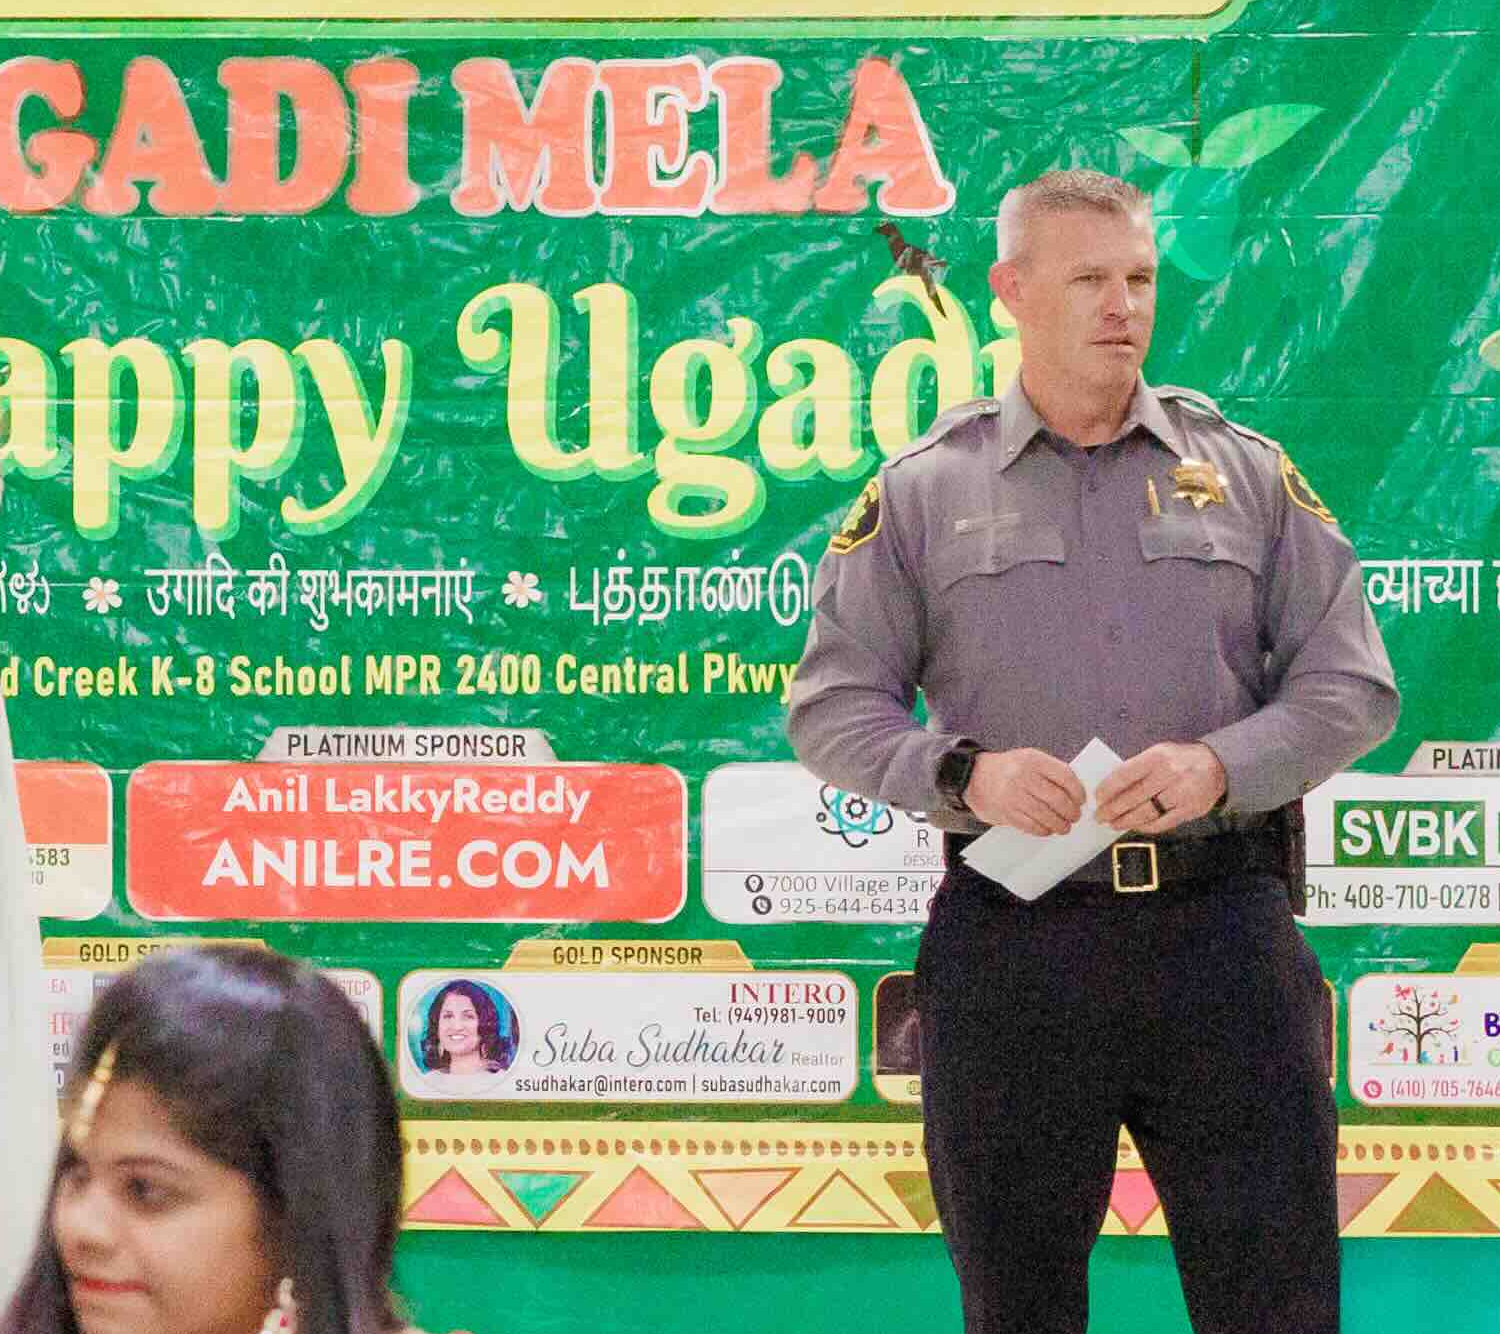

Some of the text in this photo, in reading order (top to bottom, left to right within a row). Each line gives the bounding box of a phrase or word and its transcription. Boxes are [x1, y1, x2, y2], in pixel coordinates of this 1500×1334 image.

[450, 55, 956, 218] MELA
[144, 553, 237, 619] उगादि
[246, 553, 290, 617] की
[33, 656, 138, 697] Creek
[151, 655, 216, 696] K-8
[230, 655, 351, 696] School
[365, 654, 441, 695] MPR
[456, 654, 541, 695] 2400
[555, 652, 689, 695] Central
[287, 733, 527, 758] PLATINUM SPONSOR
[222, 773, 592, 824] Anil LakkyReddy
[1341, 809, 1479, 857] SVBK
[30, 848, 71, 867] 583
[201, 838, 609, 889] ANILRE.COM
[768, 875, 939, 896] 7000 Village Park
[1304, 884, 1336, 909] Ph:
[1344, 883, 1490, 910] 408-710-0278
[79, 943, 130, 964] GOLD
[553, 946, 704, 966] GOLD SPONSOR
[730, 983, 846, 1005] INTERO
[694, 1007, 846, 1026] Tel: (949)981-9009
[533, 1022, 617, 1068] Suba
[626, 1022, 785, 1068] Sudhakar
[515, 1074, 841, 1096] ssudhakar@intero.com subasudhakar.com
